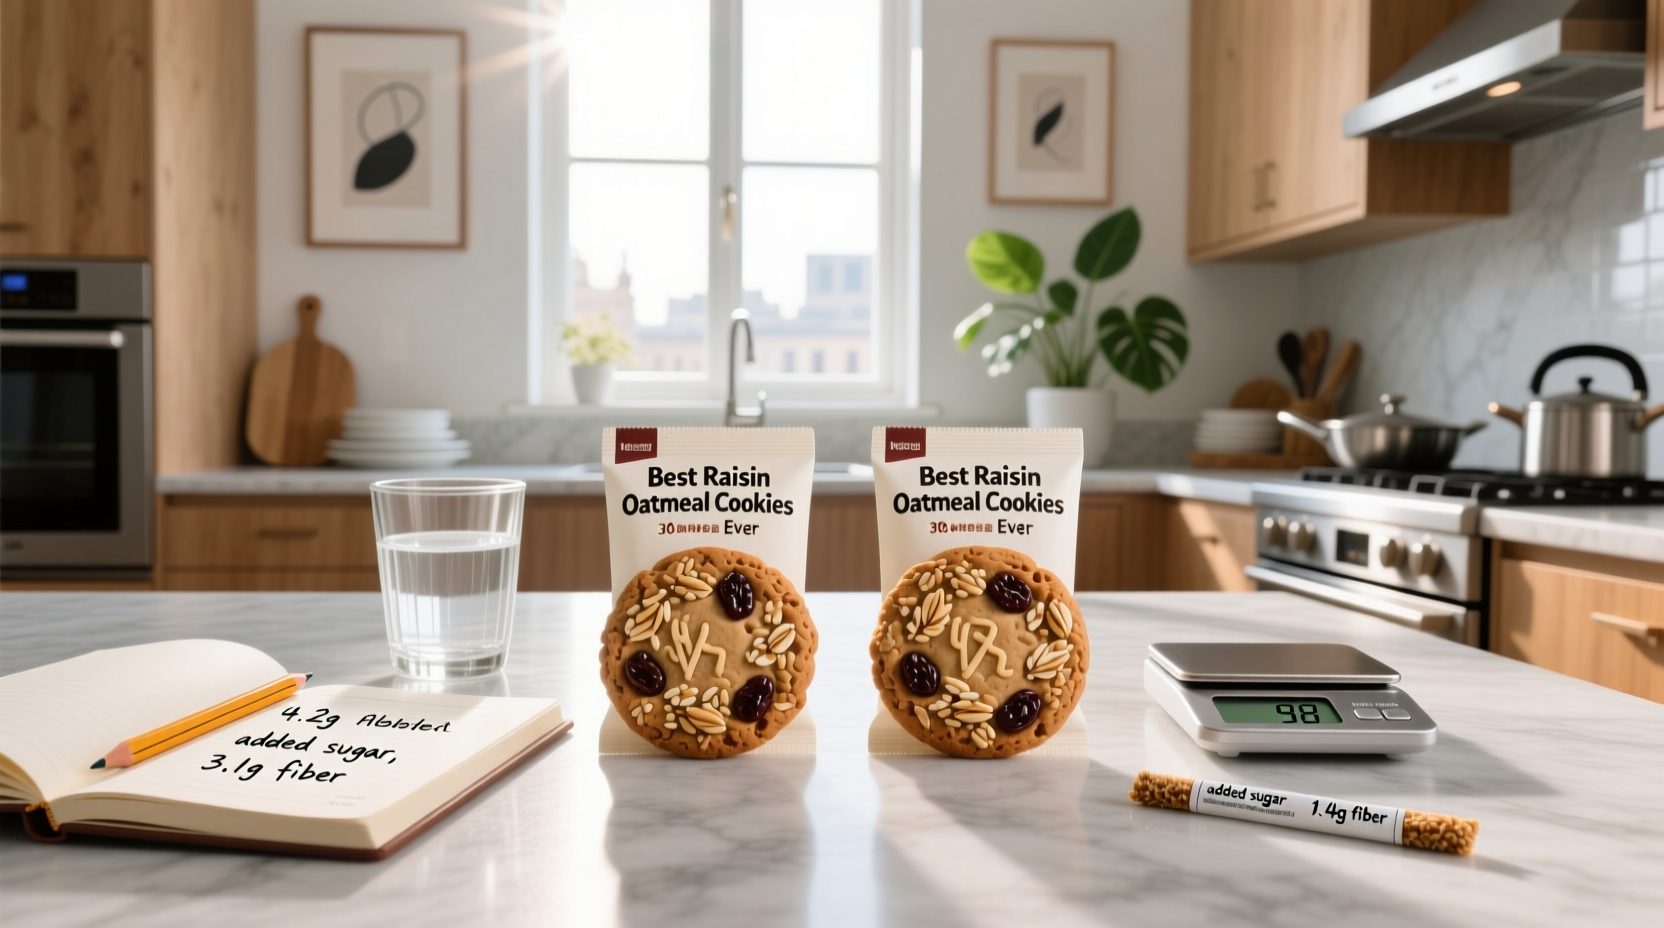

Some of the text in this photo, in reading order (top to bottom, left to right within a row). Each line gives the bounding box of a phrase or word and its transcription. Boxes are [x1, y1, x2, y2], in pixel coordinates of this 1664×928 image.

[648, 465, 770, 487] Best Raisin
[919, 464, 1041, 487] Best Raisin
[622, 491, 794, 516] Oatmeal Cookies
[893, 490, 1064, 515] Oatmeal Cookies
[658, 522, 675, 535] 30
[724, 519, 760, 535] Ever
[997, 519, 1034, 535] Ever
[281, 706, 341, 730] 4.2g
[1275, 703, 1320, 724] 98
[234, 731, 397, 764] added sugar,
[201, 754, 347, 783] 3.1g fiber
[1206, 783, 1248, 800] added
[1250, 792, 1288, 808] sugar
[1311, 799, 1347, 825] 1.4g
[1351, 805, 1388, 825] fiber
